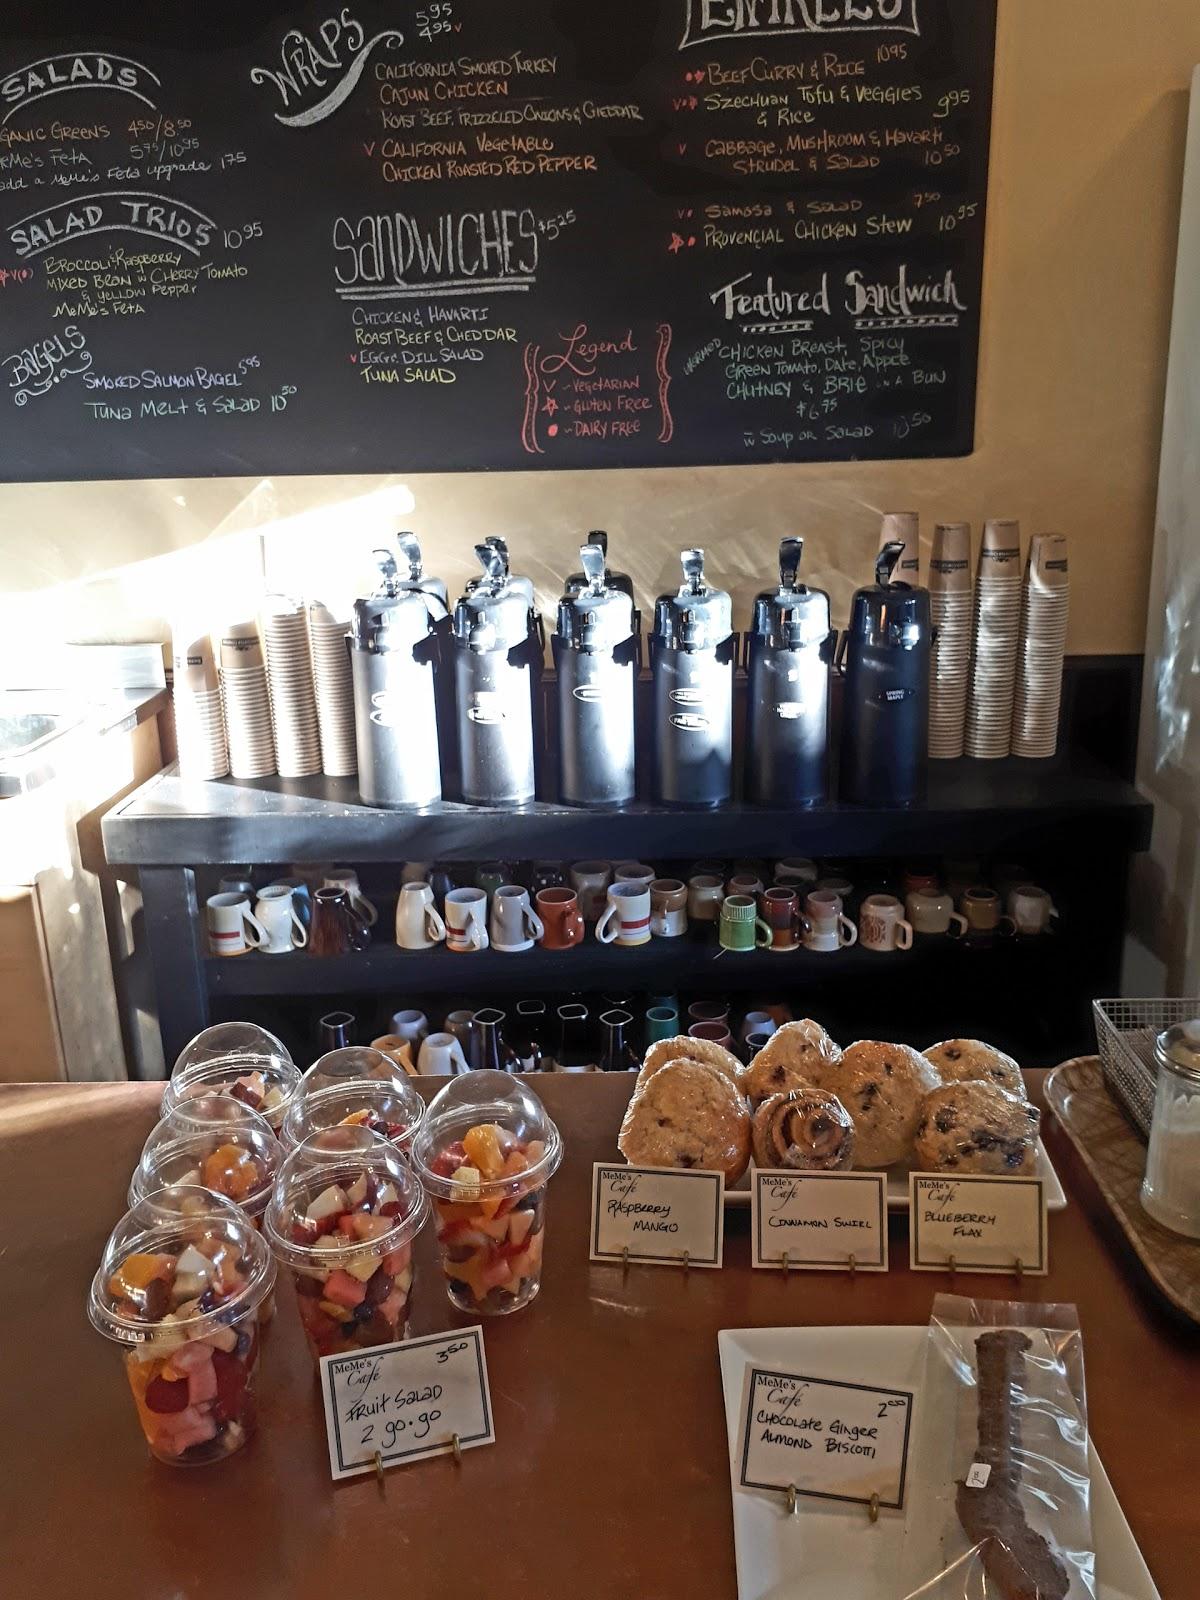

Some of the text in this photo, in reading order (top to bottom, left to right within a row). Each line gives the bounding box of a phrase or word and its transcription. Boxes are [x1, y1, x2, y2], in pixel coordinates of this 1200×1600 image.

[251, 8, 364, 106] WRAPS
[375, 50, 557, 81] CALIFORNIA SMOKED TURKEY
[1, 57, 138, 102] SALADS
[380, 81, 508, 106] CAJUN CHICKEN
[381, 138, 468, 158] CALIFORNIA
[382, 153, 598, 182] CHICKEN ROASTED RED PEPPER
[11, 205, 104, 256] SALAD
[120, 201, 210, 246] TRIOS
[710, 264, 968, 320] Featured Sandwich
[352, 306, 411, 326] CHICKEN
[428, 305, 490, 325] HAVARTI
[354, 328, 392, 346] ROAST
[394, 328, 432, 347] BEEF
[446, 325, 518, 343] CHEDDAR
[401, 350, 438, 365] DILL
[439, 346, 485, 364] SALAD
[540, 324, 638, 376] Legend
[82, 371, 141, 390] SMOKED
[141, 369, 195, 389] SALMON
[195, 366, 243, 390] BAGEL
[360, 365, 457, 384] TUNA SALAD
[573, 420, 608, 440] DAIRY
[602, 1171, 632, 1181] MeMe's
[610, 1174, 642, 1200] Café
[762, 1177, 792, 1187] MeMe's
[919, 1180, 950, 1191] MeMe's
[770, 1179, 802, 1212] Café
[927, 1182, 961, 1209] Café
[633, 1219, 679, 1233] MANGO
[768, 1215, 873, 1229] CINNAMON SWIRL
[924, 1210, 997, 1226] BLUEBERRY
[952, 1226, 984, 1238] FLAX
[335, 1358, 373, 1375] MeMe's
[346, 1356, 385, 1400] Café
[757, 1375, 797, 1391] MeMe's
[767, 1383, 811, 1417] Café
[361, 1425, 375, 1444] 2
[760, 1428, 876, 1460] ALMOND BISCOTTI
